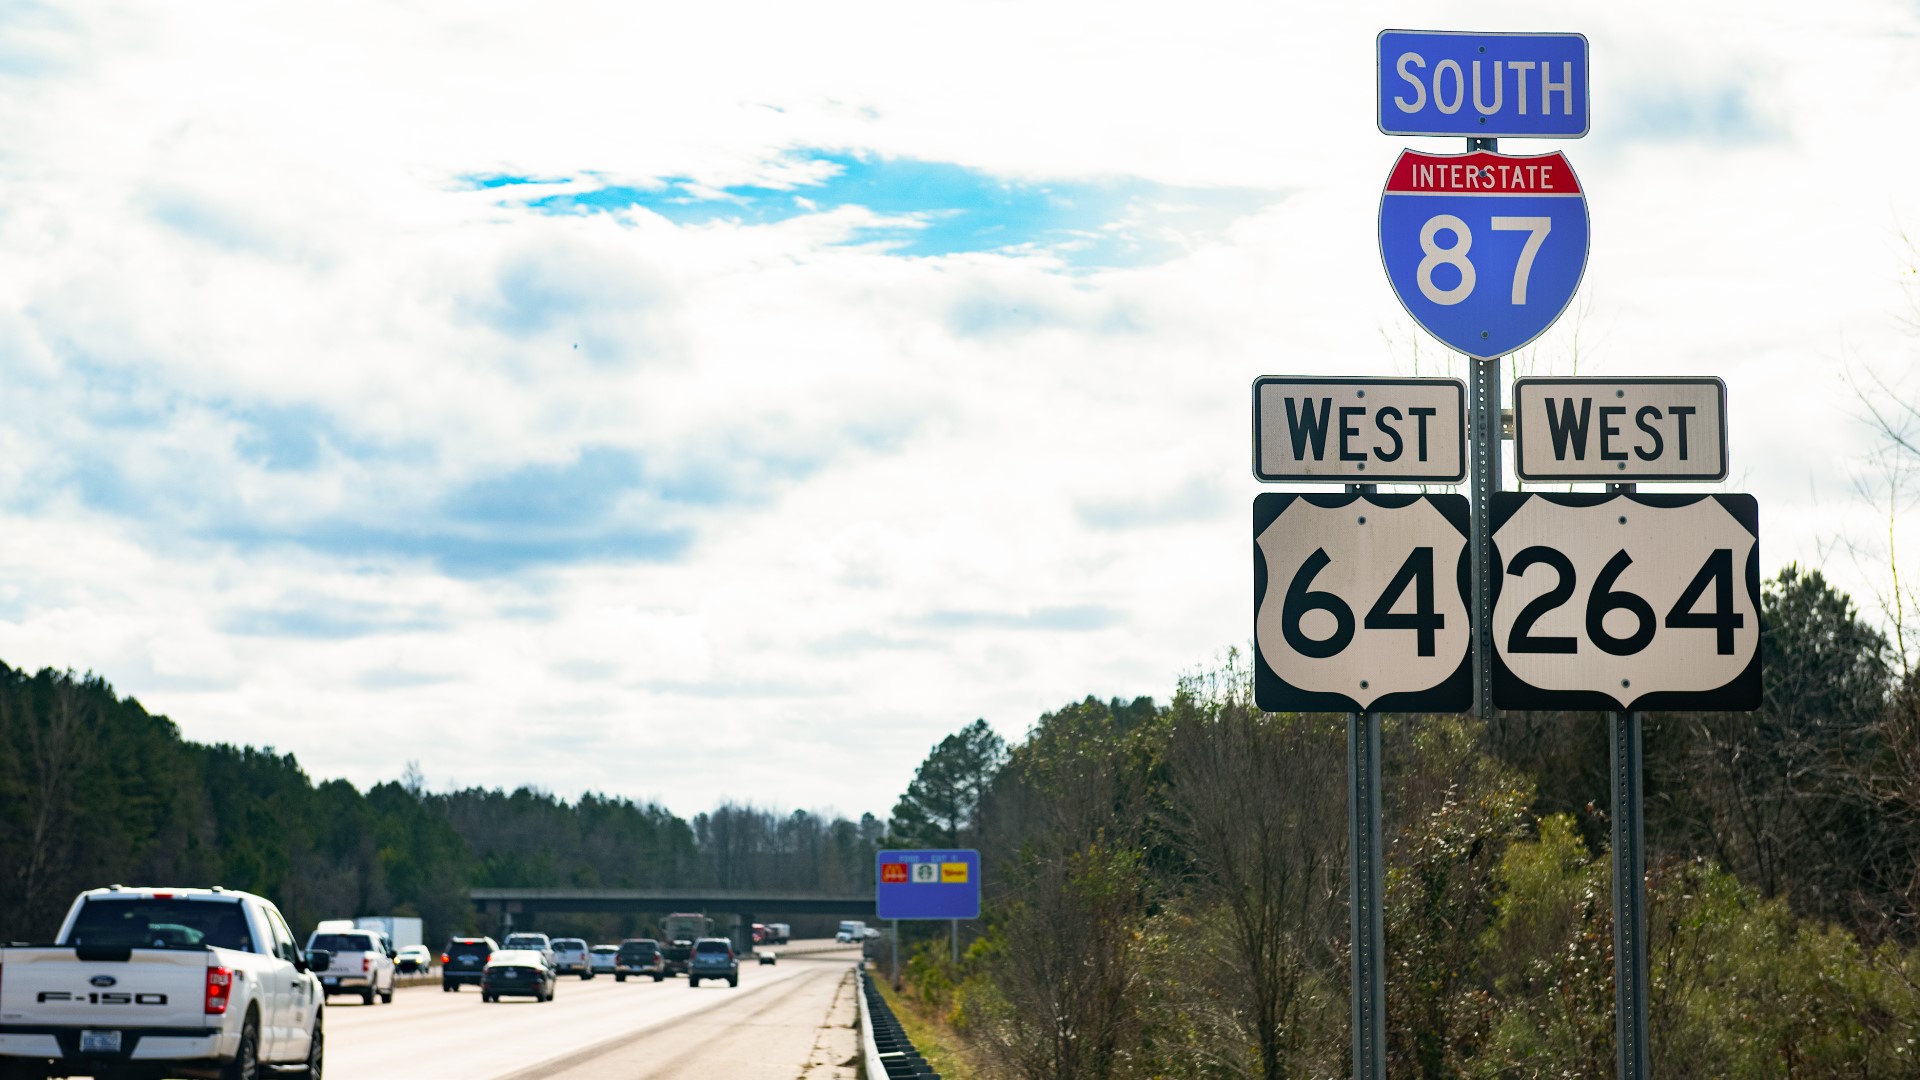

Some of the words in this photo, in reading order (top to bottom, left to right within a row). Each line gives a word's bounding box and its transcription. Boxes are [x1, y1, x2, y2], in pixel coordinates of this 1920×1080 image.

[1394, 52, 1573, 115] SOUTH
[1411, 164, 1555, 189] INTERSTATE
[1416, 214, 1552, 306] 87
[1283, 396, 1437, 463] WEST
[1544, 396, 1697, 462] WEST
[1281, 545, 1445, 659] 64
[1505, 545, 1744, 657] 264
[36, 991, 168, 1005] F-150
